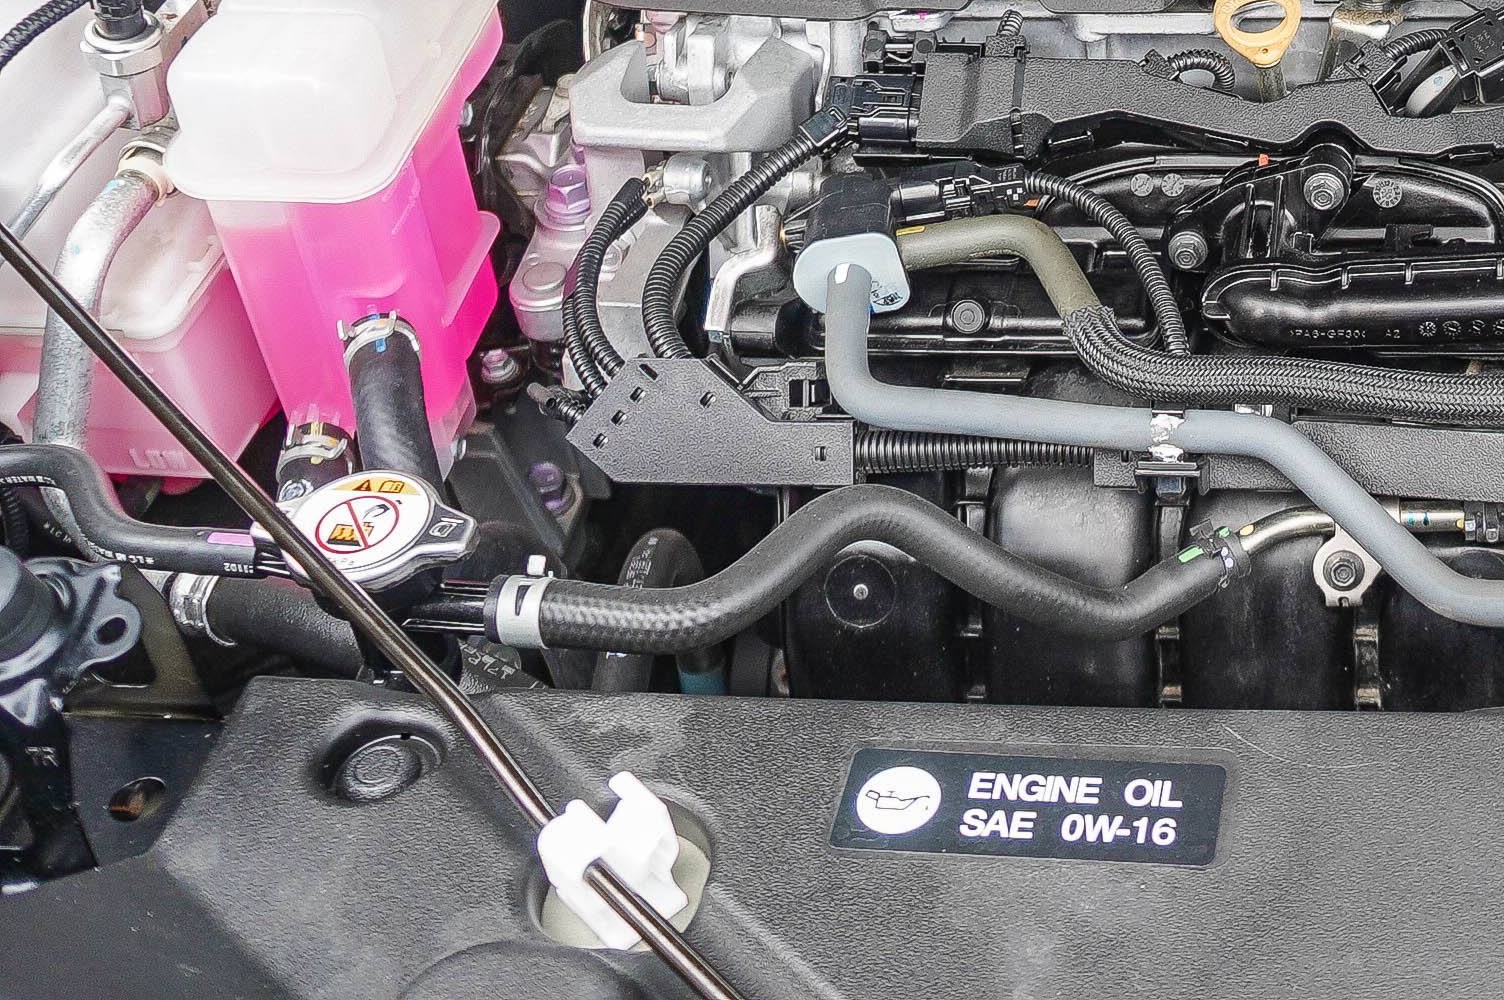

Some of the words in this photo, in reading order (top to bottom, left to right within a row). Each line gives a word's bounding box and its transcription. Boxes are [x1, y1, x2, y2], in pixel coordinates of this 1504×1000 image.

[967, 771, 1102, 804] ENGINE
[1124, 778, 1183, 808] OIL
[959, 809, 1037, 839] SAE
[1060, 813, 1177, 846] 0W-16
